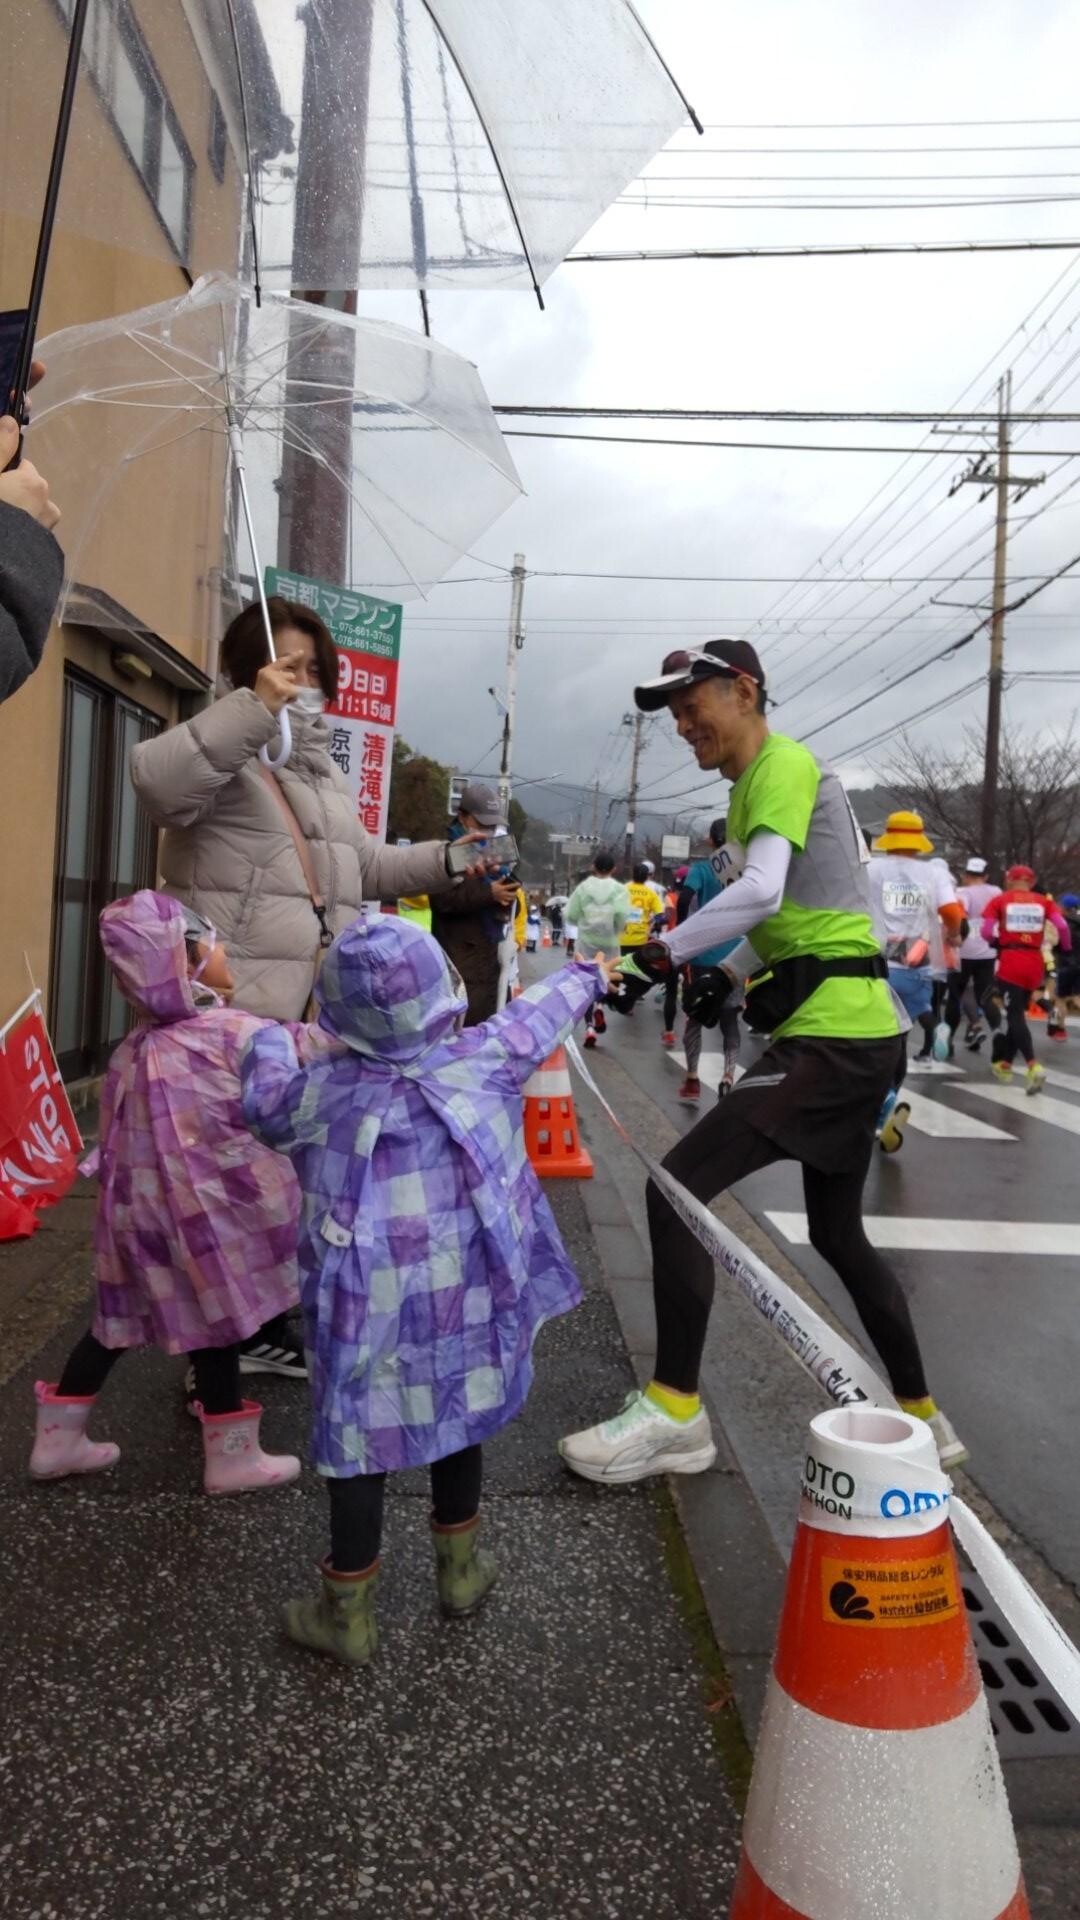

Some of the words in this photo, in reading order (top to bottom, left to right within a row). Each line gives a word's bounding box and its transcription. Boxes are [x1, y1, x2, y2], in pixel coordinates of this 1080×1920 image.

[275, 575, 397, 630] 京都マラソン
[358, 732, 386, 836] 清滝道
